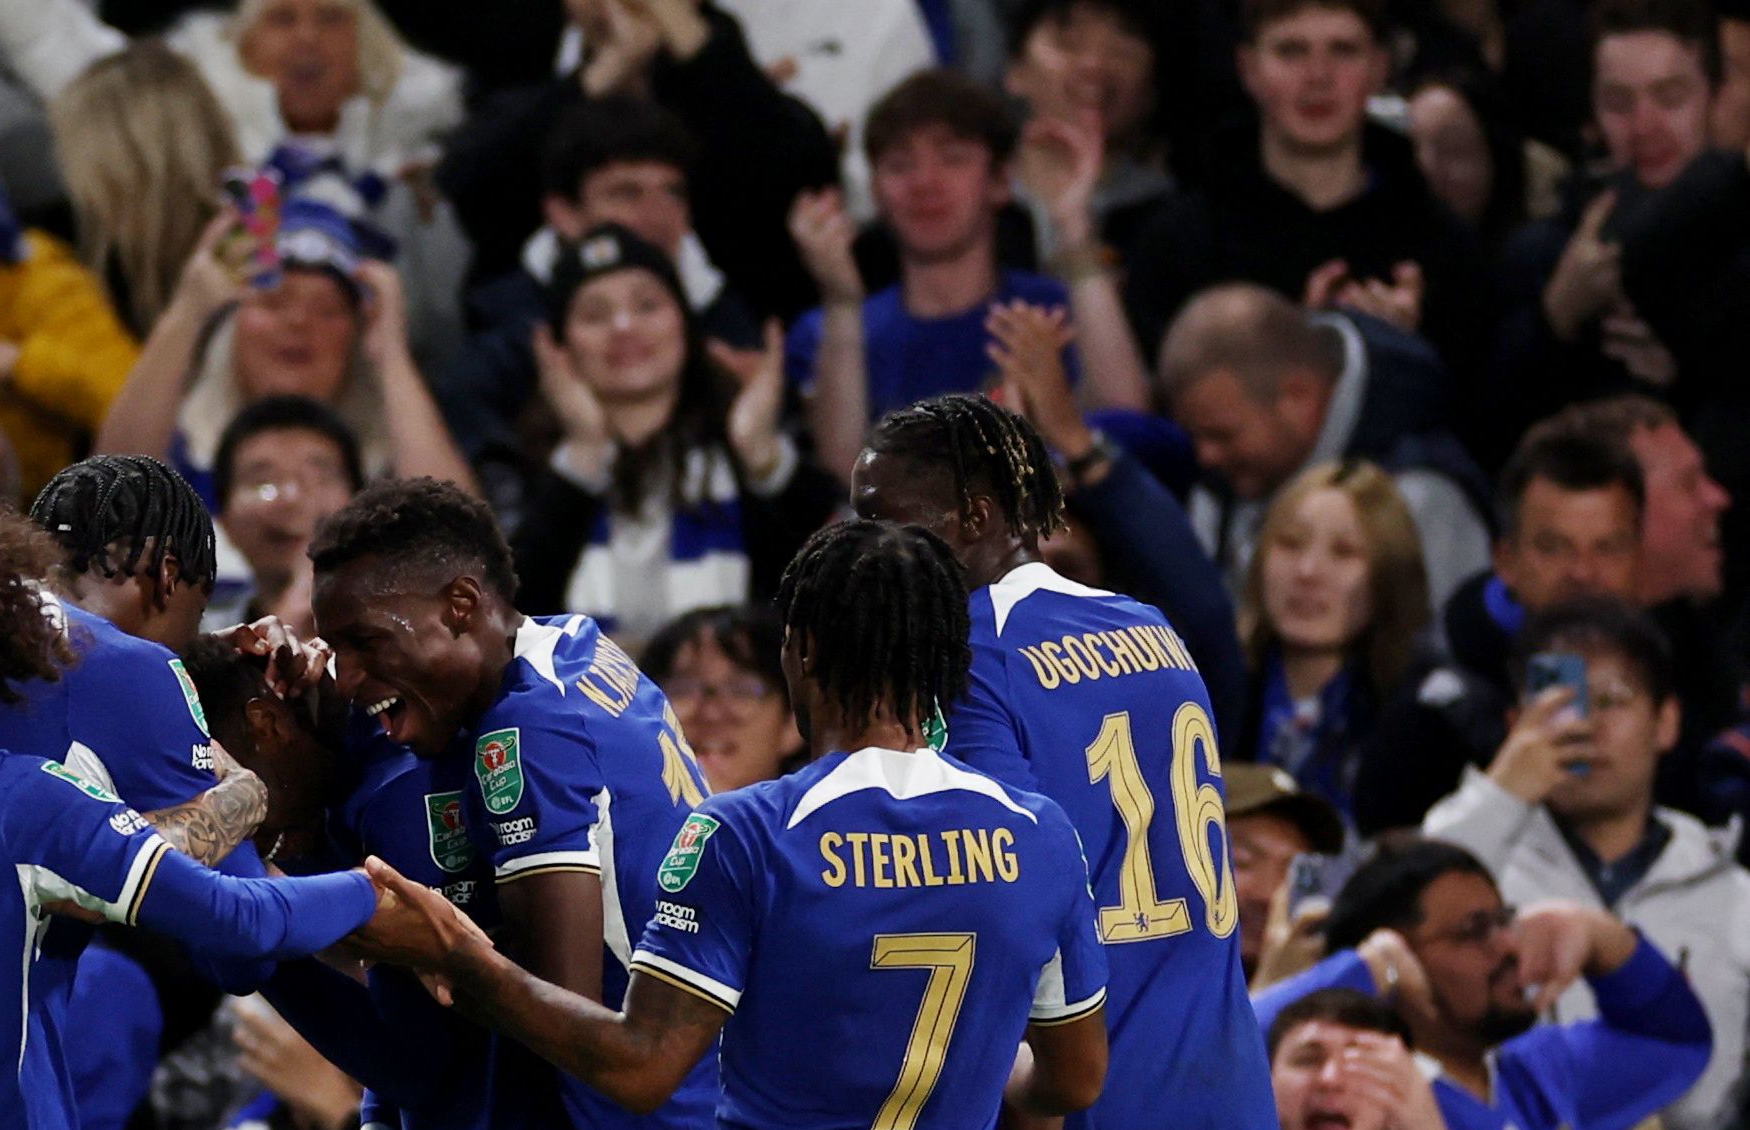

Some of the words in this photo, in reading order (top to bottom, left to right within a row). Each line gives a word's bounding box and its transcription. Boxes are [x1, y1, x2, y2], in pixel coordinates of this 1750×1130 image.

[1018, 625, 1199, 690] UGOCHUKW
[1085, 702, 1240, 946] 16
[819, 827, 1020, 889] STERLING
[658, 900, 696, 920] room
